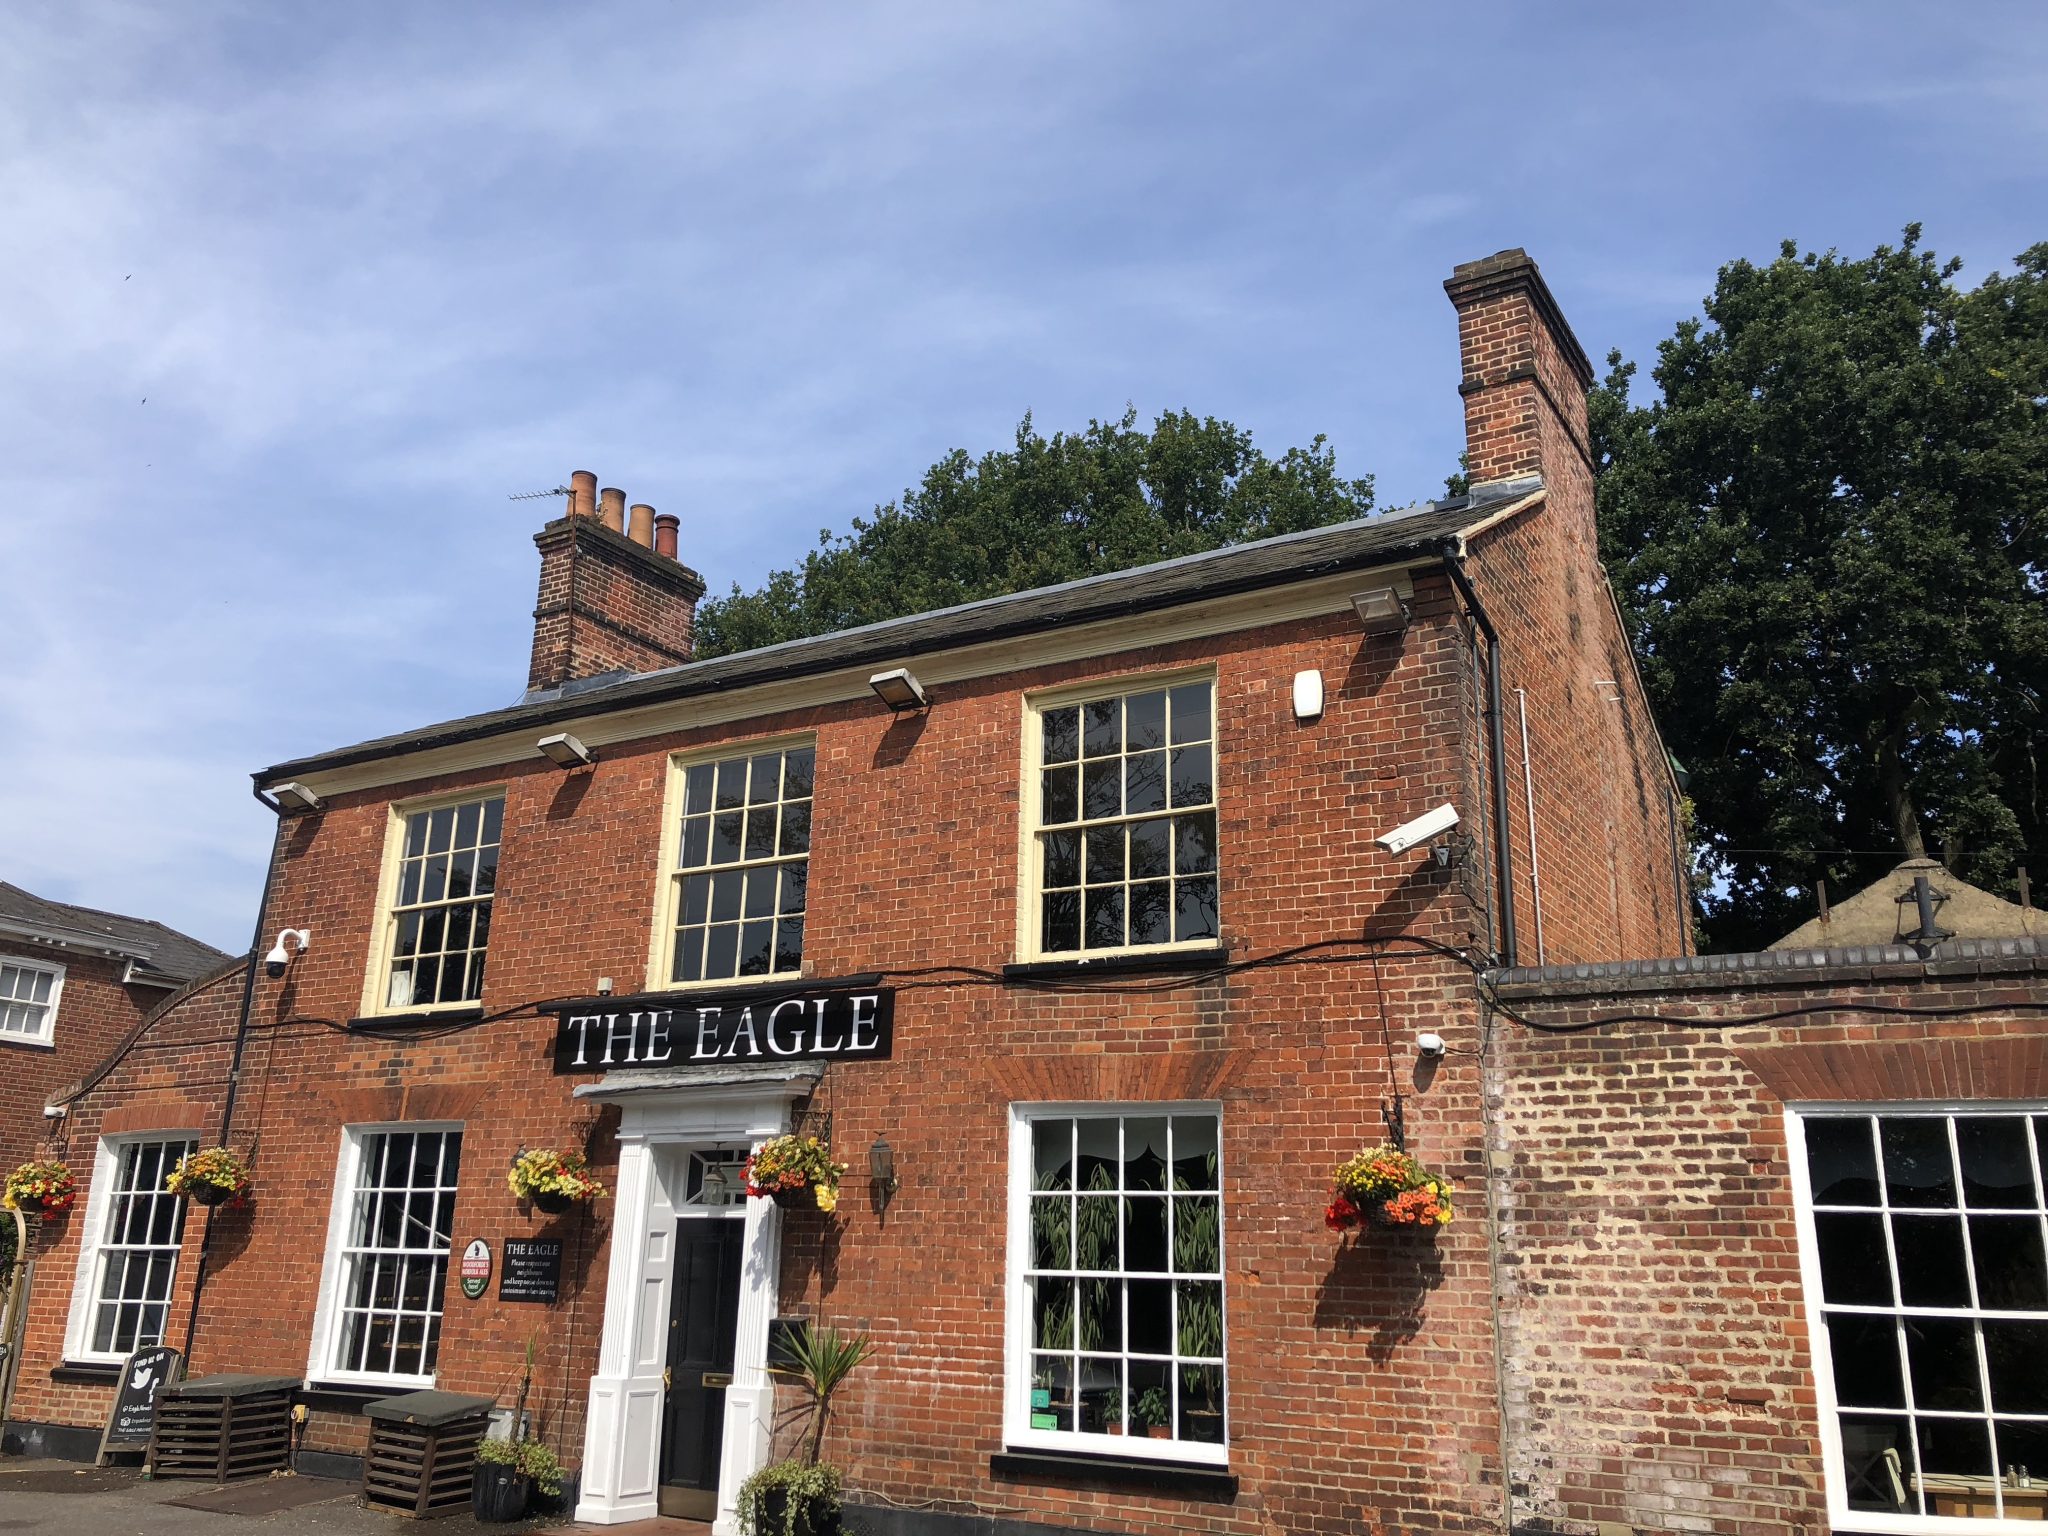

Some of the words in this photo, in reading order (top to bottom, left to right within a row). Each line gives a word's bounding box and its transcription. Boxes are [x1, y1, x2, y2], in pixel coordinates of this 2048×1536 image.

[568, 1009, 672, 1065] THE
[690, 994, 879, 1059] EAGLE
[507, 1244, 526, 1256] THE
[528, 1244, 559, 1256] EAGLE
[511, 1259, 526, 1267] Please
[134, 1358, 148, 1369] FIND
[156, 1352, 164, 1361] ON
